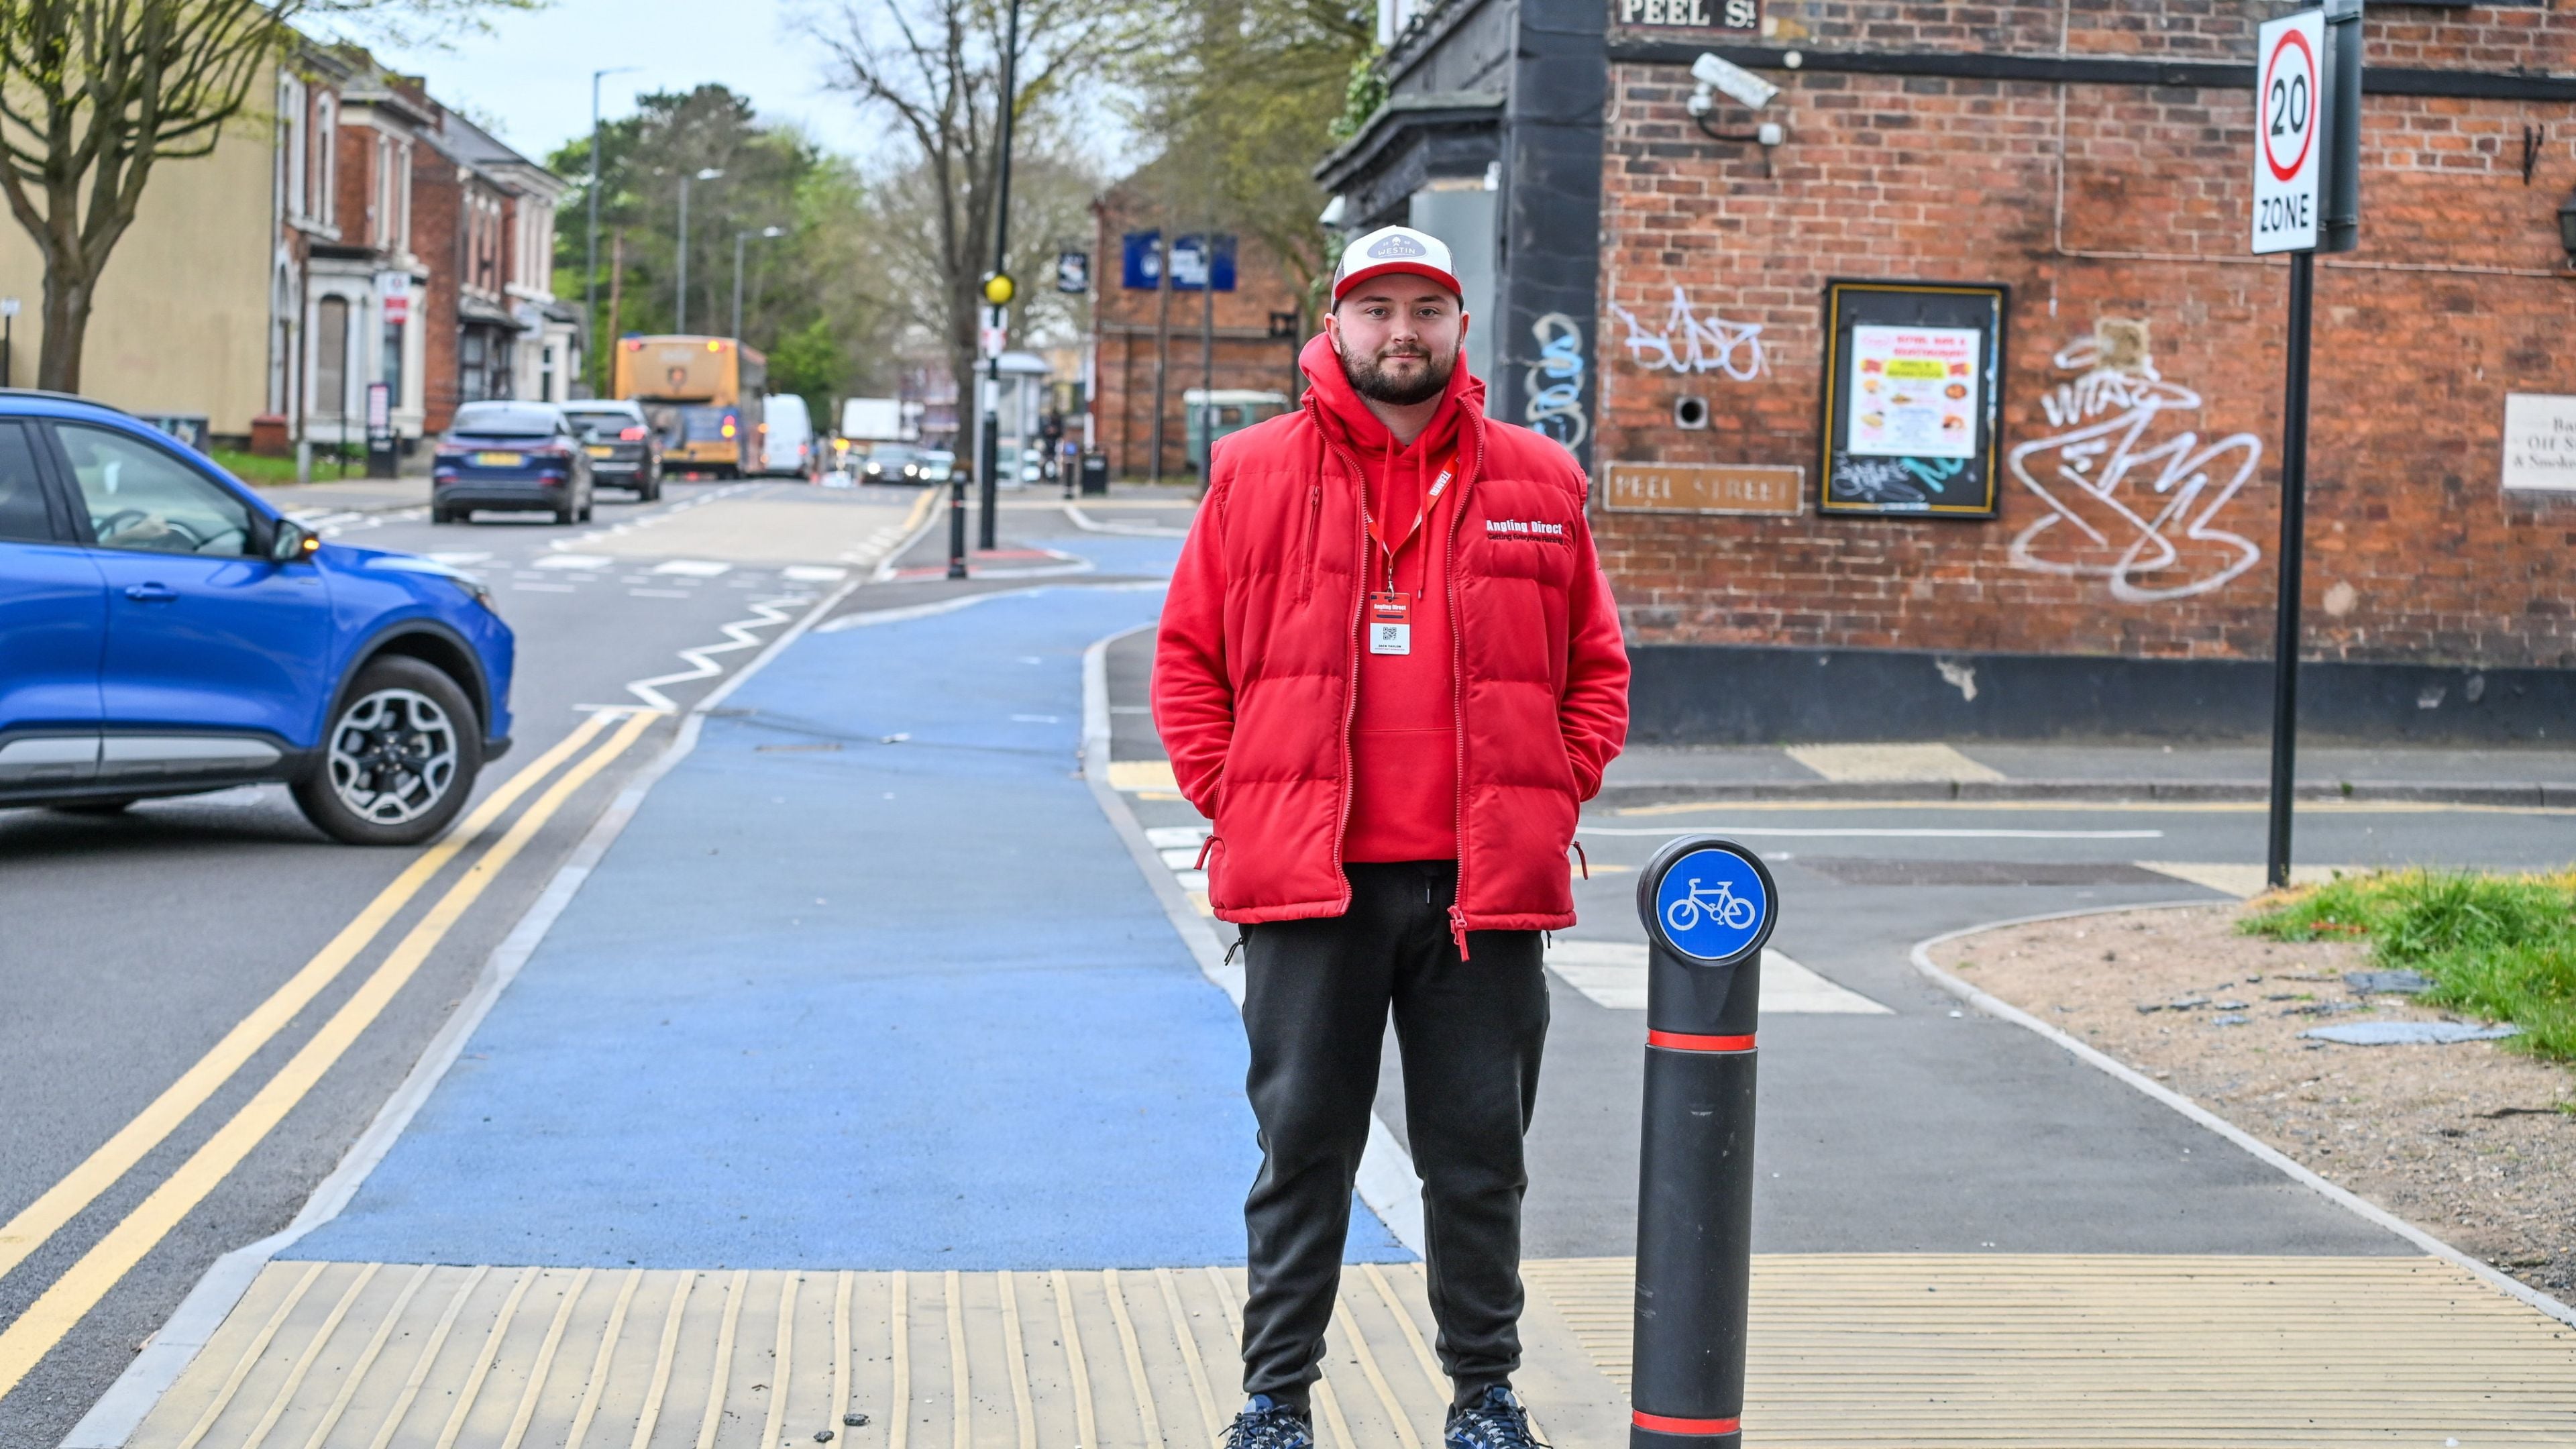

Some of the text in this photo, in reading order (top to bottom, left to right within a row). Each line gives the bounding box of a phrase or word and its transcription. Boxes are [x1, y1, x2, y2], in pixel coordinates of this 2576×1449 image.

[1621, 0, 1711, 27] PEEL
[2270, 73, 2307, 136] 20
[2259, 194, 2310, 233] ZONE
[1377, 247, 1416, 256] WESTIN
[1615, 474, 1787, 502] PEEL STREET
[1486, 519, 1562, 535] Angling Direct
